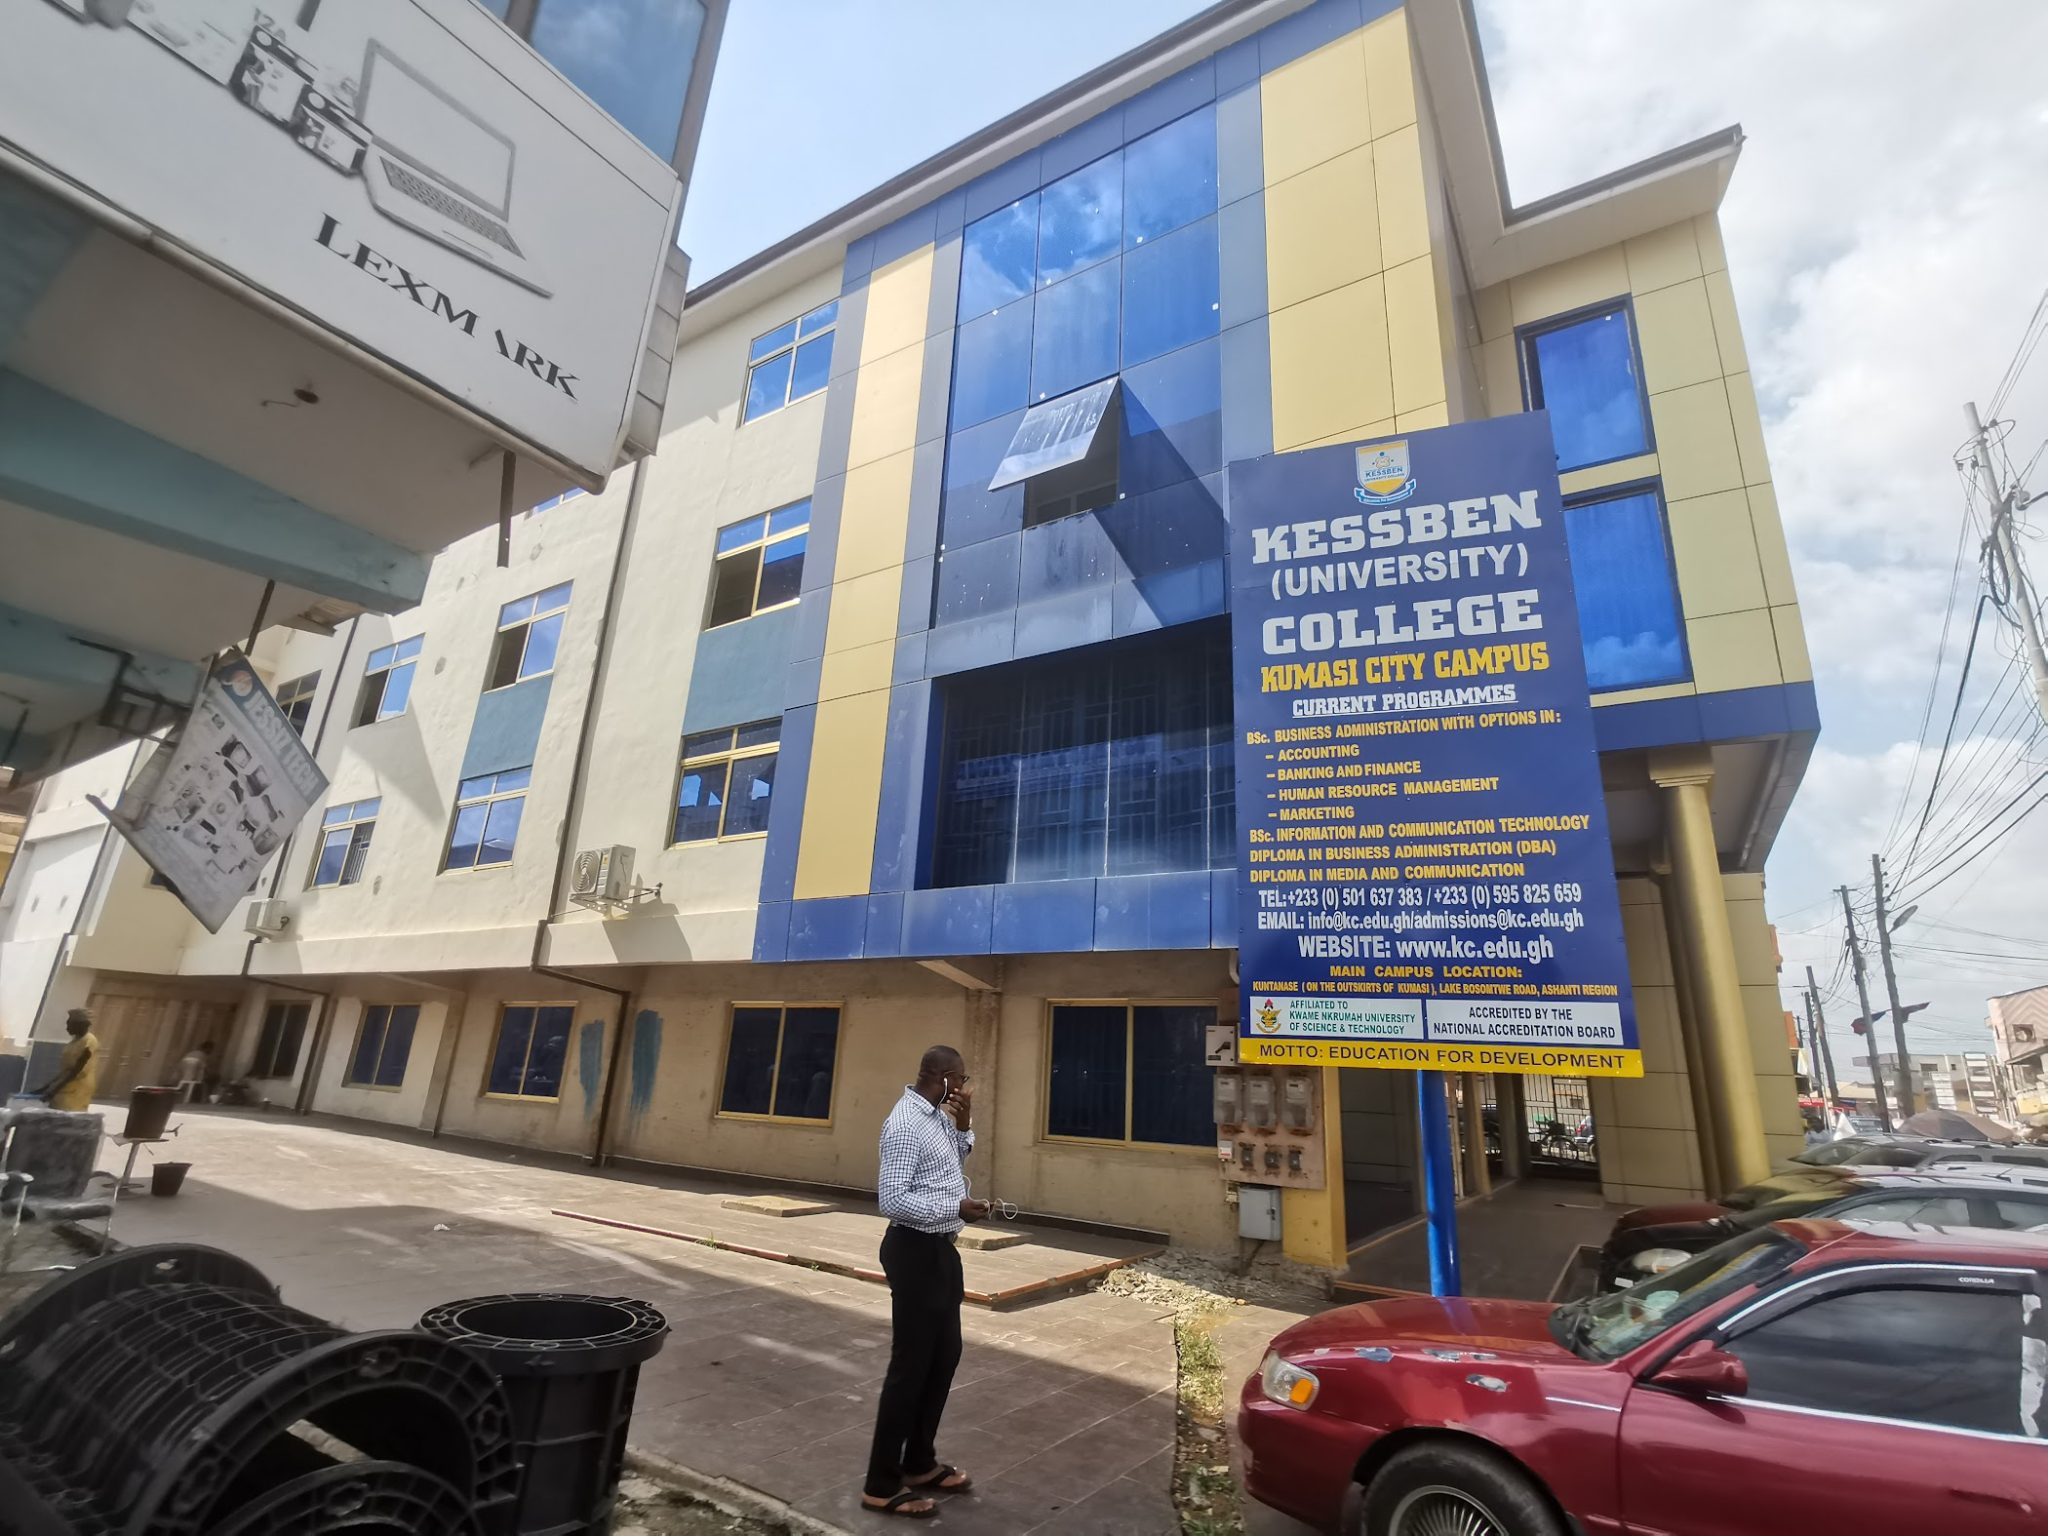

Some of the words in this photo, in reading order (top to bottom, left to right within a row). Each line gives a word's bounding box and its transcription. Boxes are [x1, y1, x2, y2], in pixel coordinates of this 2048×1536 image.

[1365, 466, 1403, 478] KESSBEN
[1252, 490, 1542, 564] KESSBEN
[1272, 542, 1529, 600] (UNIVERSITY)
[1262, 589, 1543, 655] COLLEGE
[1261, 658, 1358, 692] KUMASI
[1365, 653, 1425, 684] CITY
[1434, 641, 1550, 678] CAMPUS
[1293, 696, 1377, 717] CURRENT
[1382, 684, 1517, 711] PROGRAMMES
[1247, 732, 1270, 745] BSc.
[1275, 726, 1332, 743] BUSINESS
[1335, 718, 1439, 738] ADMINISTRATION
[1441, 715, 1474, 730] WITH
[1479, 710, 1536, 727] OPTIONS
[1540, 709, 1561, 724] IN:
[1277, 744, 1360, 761] ACCOUNTING
[1277, 766, 1334, 781] BANKING
[1336, 765, 1363, 778] AND
[1364, 761, 1421, 776] FINANCE
[1279, 787, 1324, 801] HUMAN
[1328, 783, 1397, 799] RESOURCE
[1403, 777, 1499, 795] MANAGEMENT
[1280, 806, 1355, 821] MARKETING
[1250, 829, 1274, 843] BSc.
[1277, 825, 1356, 842] INFORMATION
[1359, 824, 1384, 838] AND
[1388, 819, 1495, 838] COMMUNICATION
[1499, 815, 1590, 833] TECHNOLOGY
[1250, 849, 1305, 862] DIPLOMA
[1309, 848, 1322, 861] IN
[1326, 846, 1390, 860] BUSINESS
[1394, 841, 1512, 858] ADMINISTRATION
[1516, 839, 1557, 857] (DBA)
[1250, 869, 1306, 882] DIPLOMA
[1309, 869, 1323, 881] IN
[1326, 868, 1367, 881] MEDIA
[1371, 867, 1399, 879] AND
[1404, 863, 1525, 879] COMMUNICATION
[1322, 887, 1339, 911] (0)
[1343, 887, 1366, 906] 501
[1370, 887, 1394, 906] 637
[1397, 887, 1423, 905] 383
[1434, 885, 1467, 905] +233
[1471, 885, 1490, 909] (0)
[1493, 884, 1520, 904] 595
[1523, 884, 1550, 903] 825
[1554, 883, 1582, 902] 659
[1258, 911, 1304, 930] EMAIL:
[1298, 935, 1391, 958] WEBSITE:
[1396, 934, 1554, 965] www.kc.edu.gh
[1330, 966, 1366, 977] MAIN
[1374, 966, 1434, 978] CAMPUS
[1443, 966, 1523, 978] LOCATION:
[1252, 981, 1298, 992] KUNTANASE
[1319, 982, 1336, 992] THE
[1336, 982, 1381, 993] OUTSKIRTS
[1382, 983, 1394, 993] OF
[1439, 983, 1462, 994] LAKE
[1463, 984, 1512, 995] BOSOMTWE
[1513, 984, 1540, 997] ROAD,
[1542, 984, 1581, 996] ASHANTI
[1582, 985, 1618, 996] REGION
[1290, 1000, 1335, 1010] AFFILIATED
[1337, 1001, 1349, 1010] TO
[1469, 1007, 1532, 1019] ACCREDITED
[1534, 1008, 1549, 1019] BY
[1551, 1009, 1572, 1020] THE
[1289, 1011, 1320, 1021] KWAME
[1321, 1012, 1362, 1022] NKRUMAH
[1364, 1013, 1416, 1023] UNIVERSITY
[1290, 1022, 1300, 1031] OF
[1302, 1022, 1337, 1032] SCIENCE
[1339, 1023, 1346, 1033] &
[1347, 1024, 1405, 1035] TECHNOLOGY
[1433, 1023, 1486, 1035] NATIONAL
[1488, 1024, 1574, 1037] ACCREDITATION
[1577, 1026, 1616, 1039] BOARD
[1260, 1044, 1324, 1058] MOTTO:
[1329, 1046, 1430, 1061] EDUCATION
[1437, 1050, 1474, 1064] FOR
[1480, 1051, 1625, 1069] DEVELOPMENT
